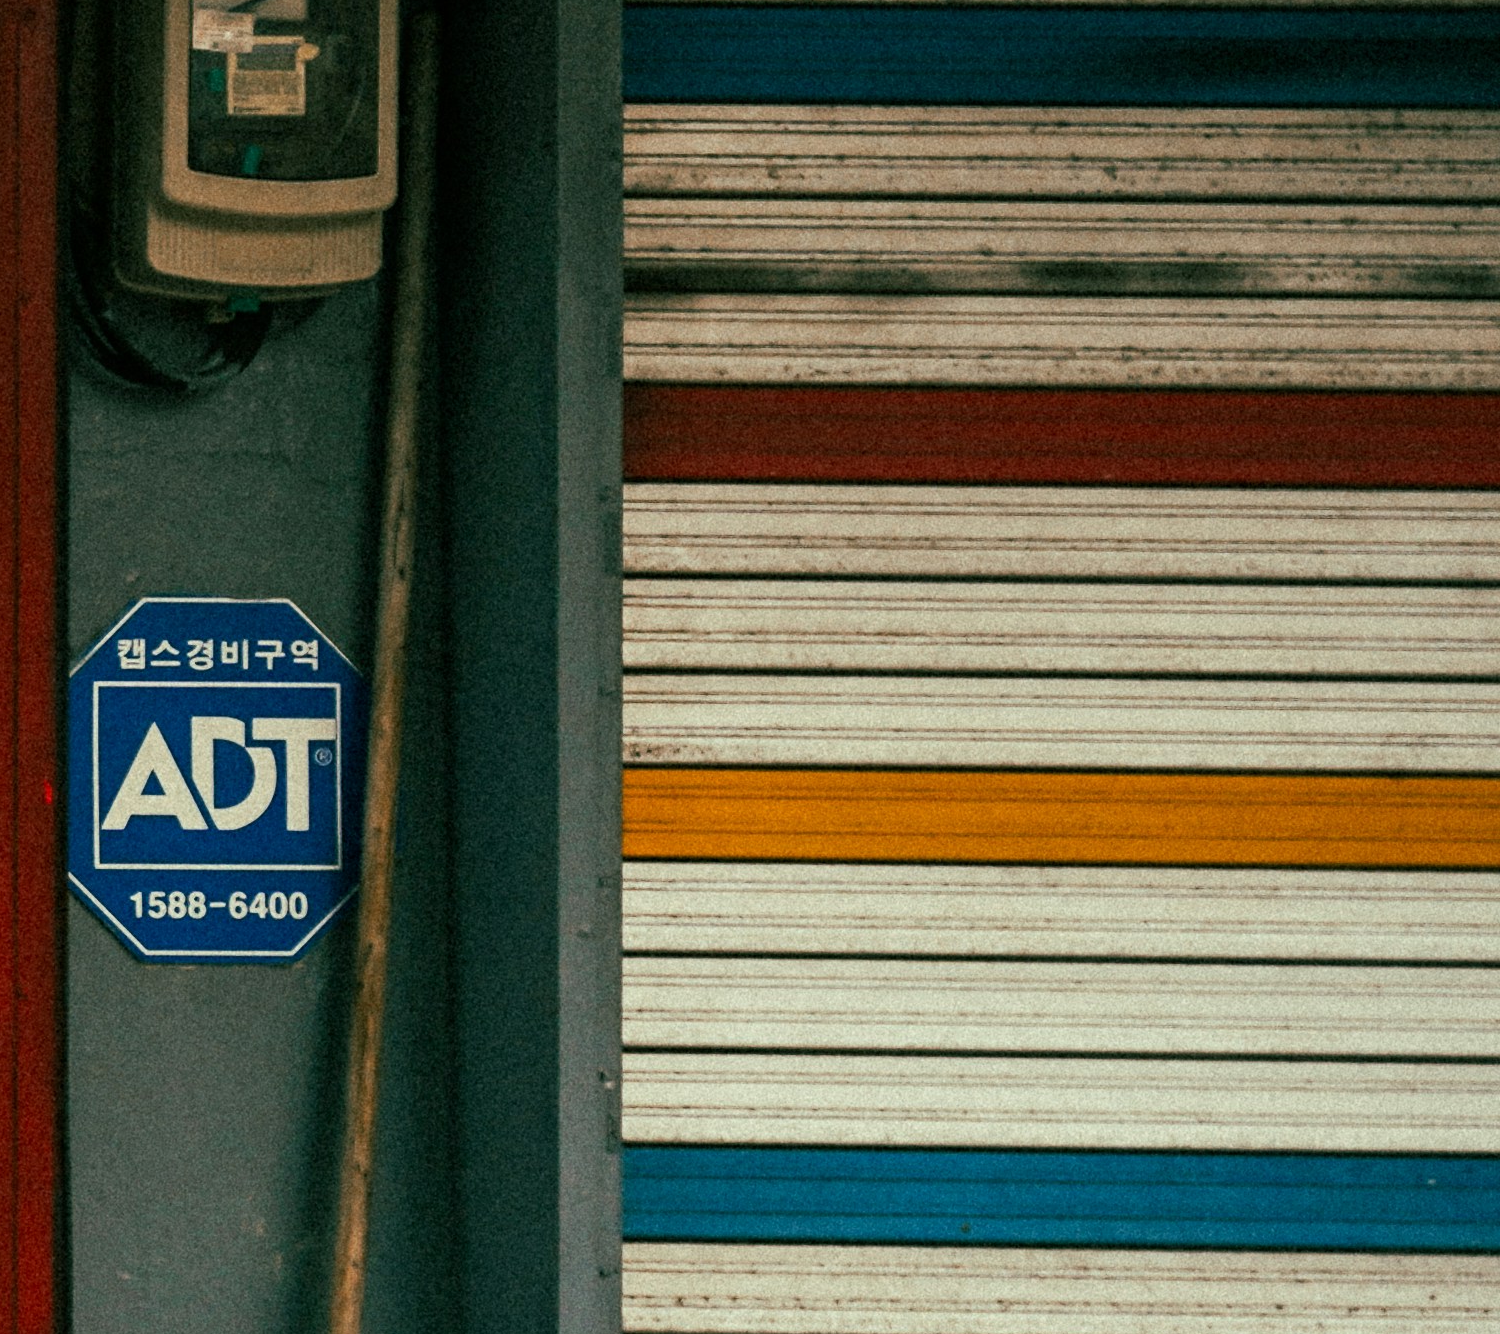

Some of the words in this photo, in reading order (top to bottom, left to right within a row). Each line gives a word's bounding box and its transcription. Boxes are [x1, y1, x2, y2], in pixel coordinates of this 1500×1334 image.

[118, 638, 319, 670] 캡스경비구역
[102, 716, 336, 831] ADT
[130, 891, 308, 920] 1588-6400
